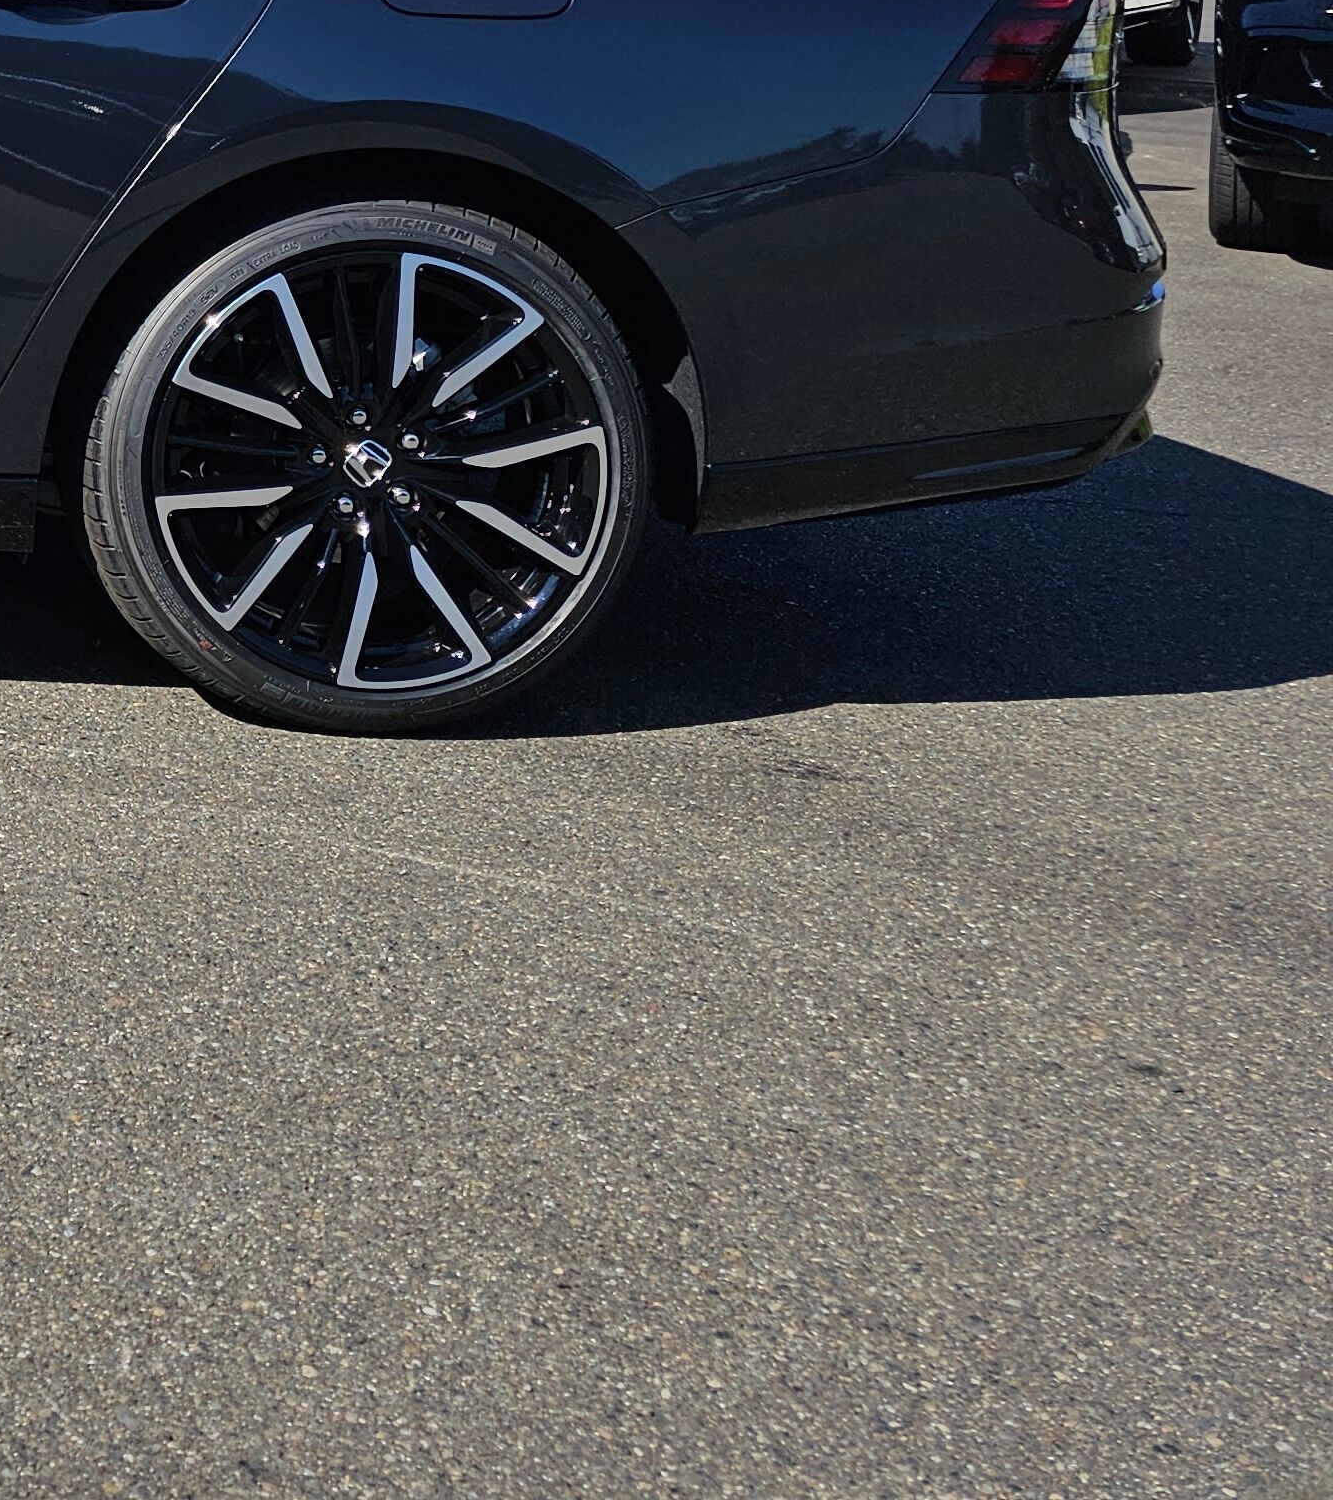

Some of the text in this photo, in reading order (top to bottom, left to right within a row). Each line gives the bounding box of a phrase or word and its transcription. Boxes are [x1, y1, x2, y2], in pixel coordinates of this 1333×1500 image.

[377, 217, 470, 242] MICHELIN
[253, 241, 299, 267] EXTRA LOAD
